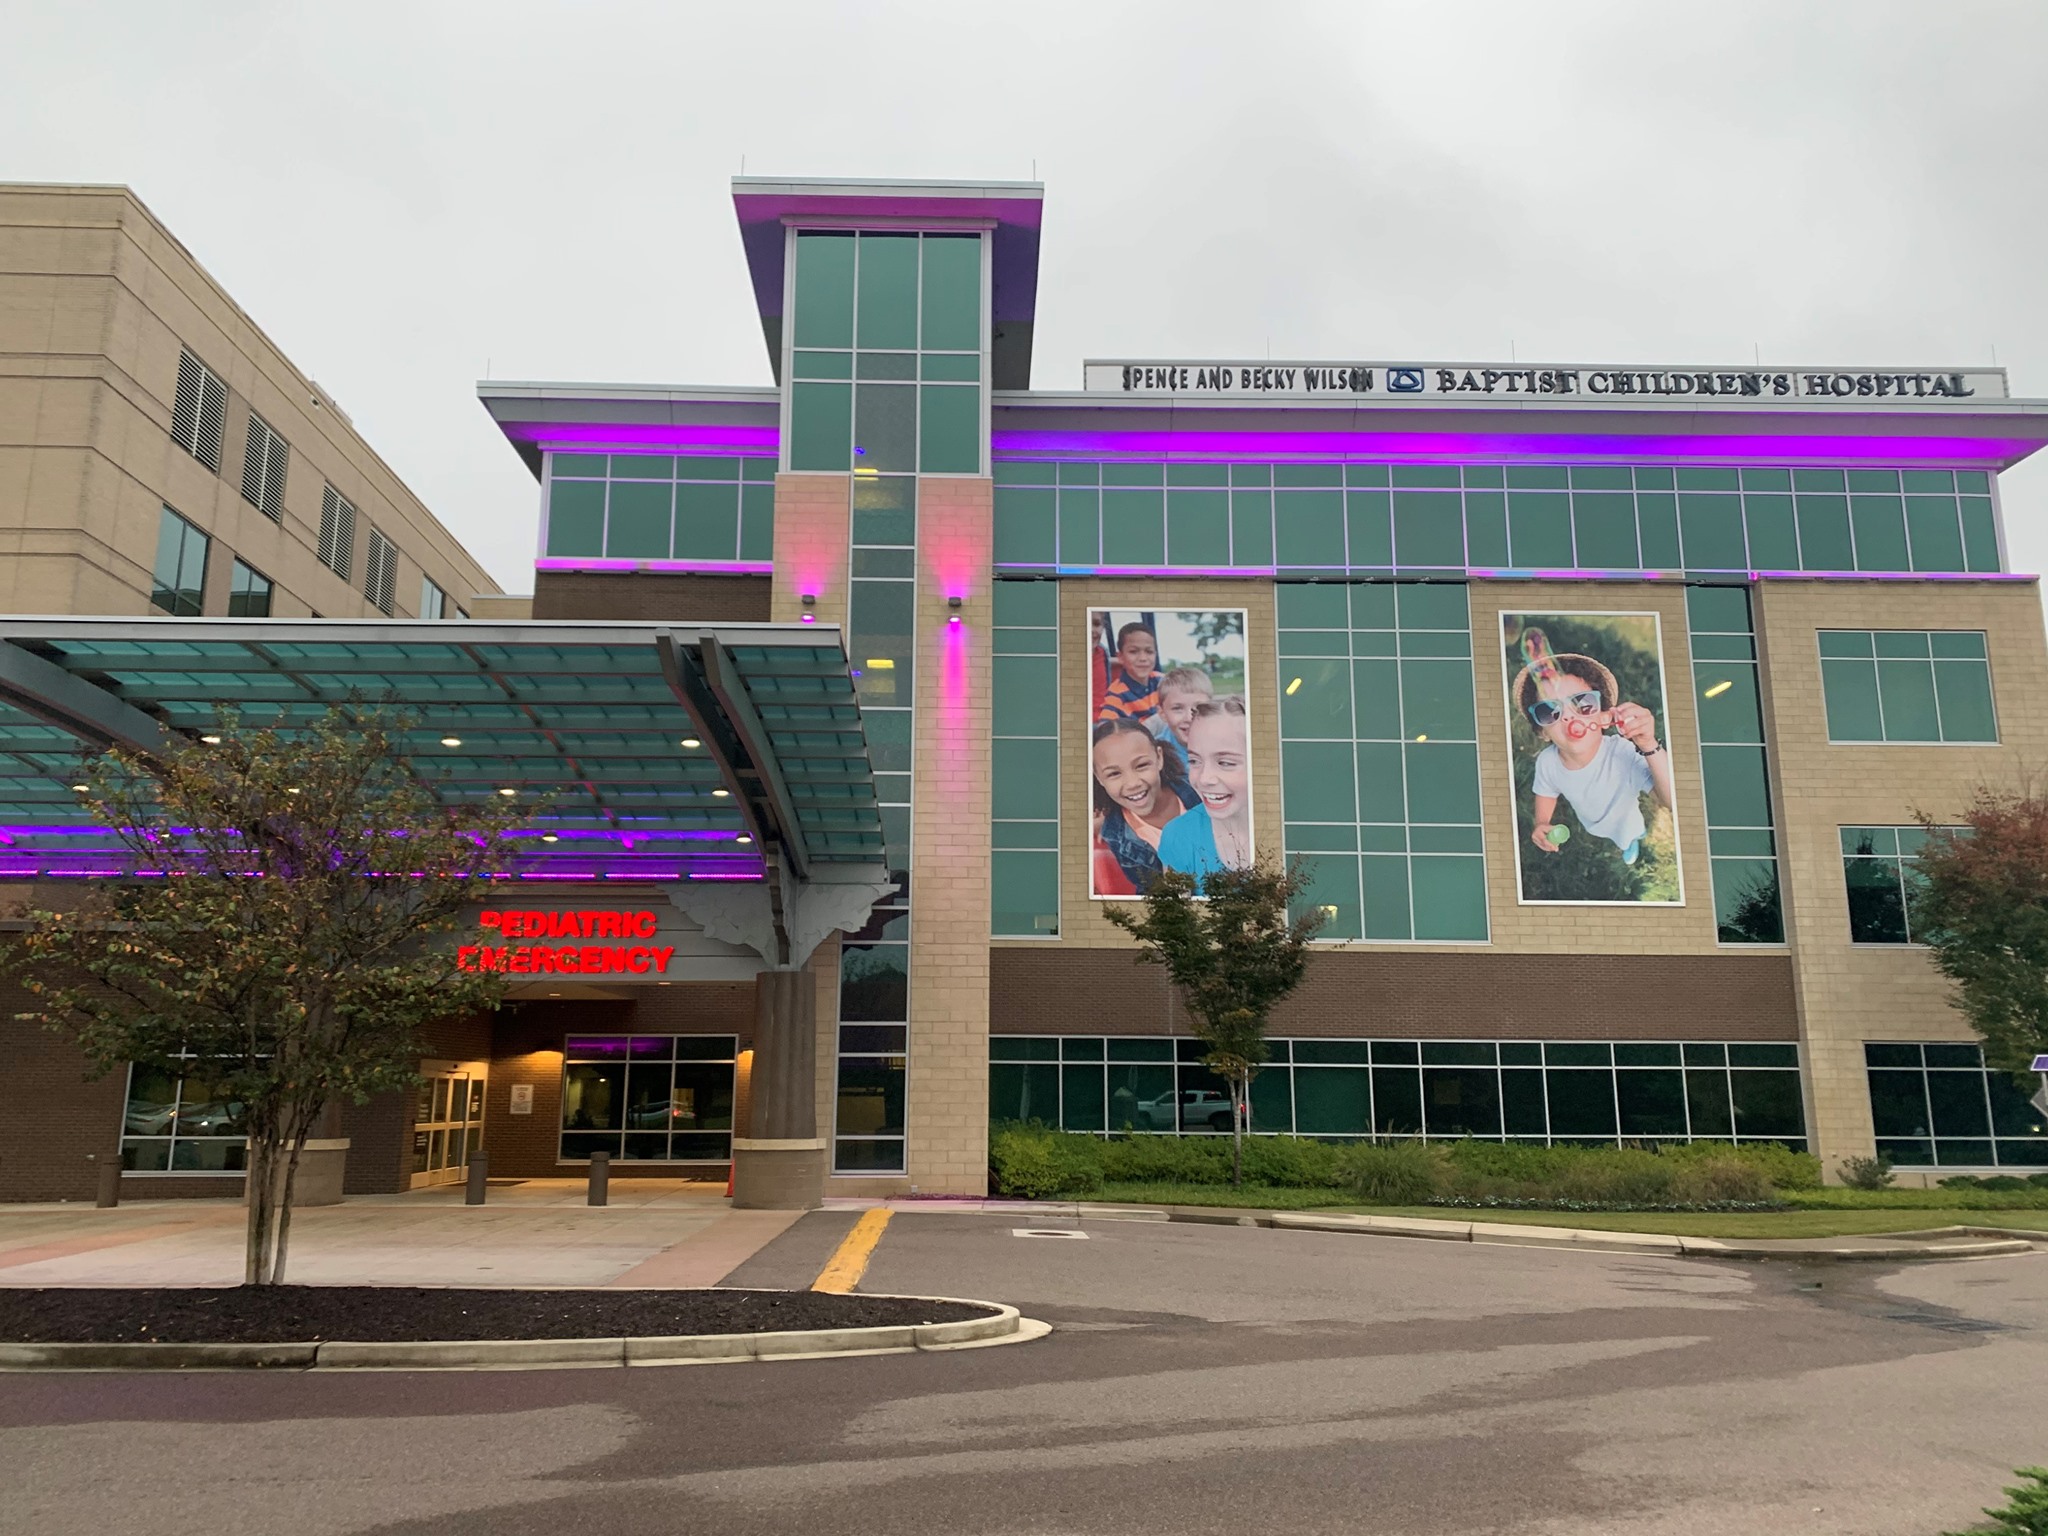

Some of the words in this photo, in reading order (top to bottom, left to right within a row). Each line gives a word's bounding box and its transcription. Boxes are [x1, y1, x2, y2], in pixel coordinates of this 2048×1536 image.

[1122, 367, 1188, 391] SPENCE
[1196, 368, 1233, 390] AND
[1240, 368, 1295, 390] BECKY
[1304, 368, 1374, 391] WILSON
[1436, 369, 1578, 393] BAPTIST
[1588, 372, 1790, 396] CHILDREN'S
[1804, 373, 1975, 397] HOSPITAL
[480, 911, 657, 937] PEDIATRIC
[457, 946, 674, 973] EMERGENCY
